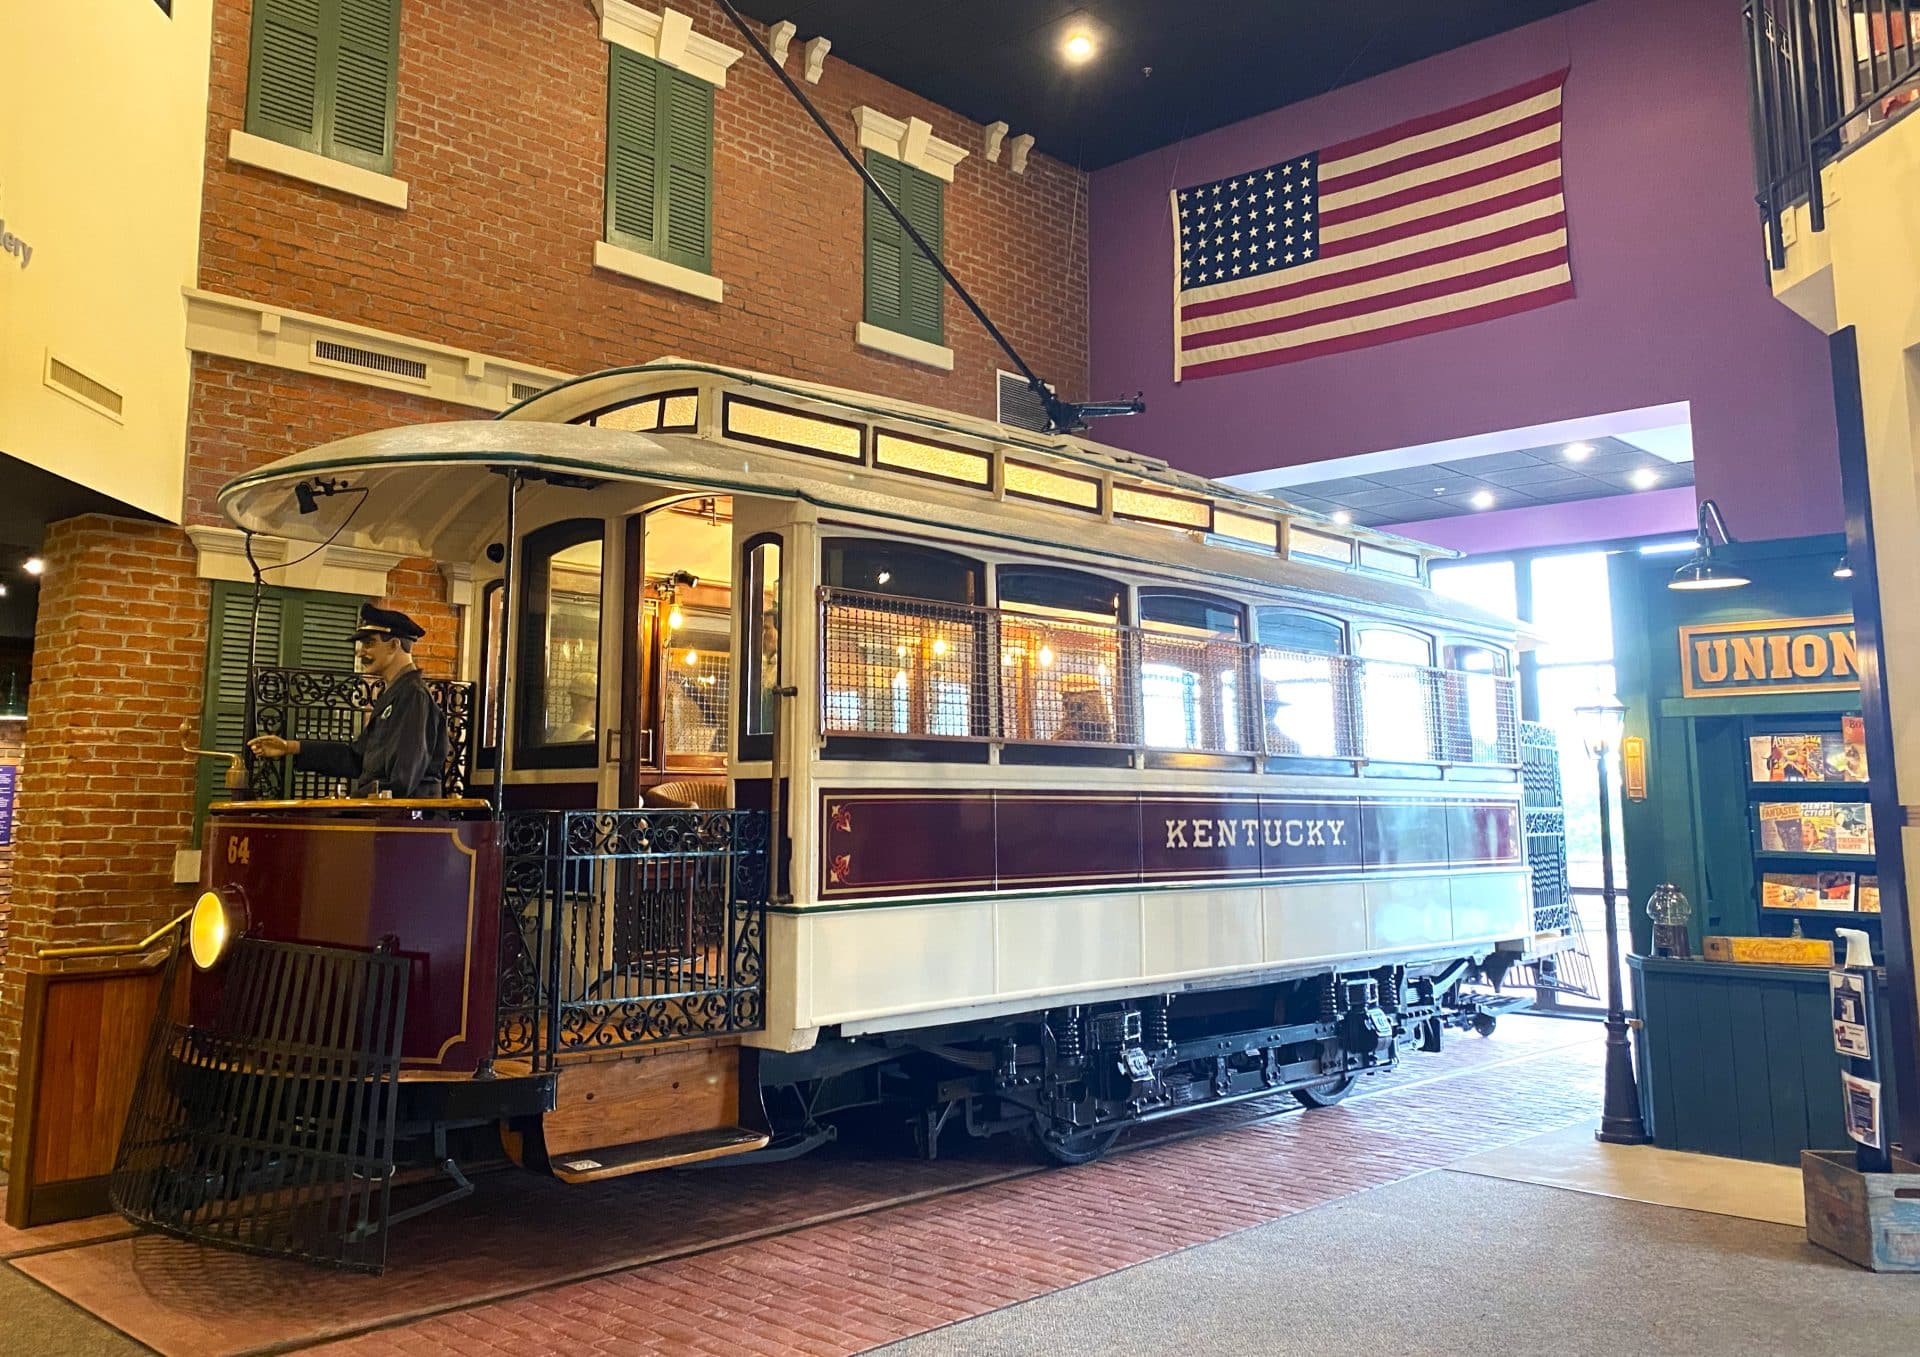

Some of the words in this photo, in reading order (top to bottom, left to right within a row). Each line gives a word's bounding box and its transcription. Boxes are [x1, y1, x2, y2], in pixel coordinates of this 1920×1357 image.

[1695, 631, 1859, 682] UNION
[1165, 819, 1347, 848] KENTUCKY.
[228, 836, 250, 865] 64
